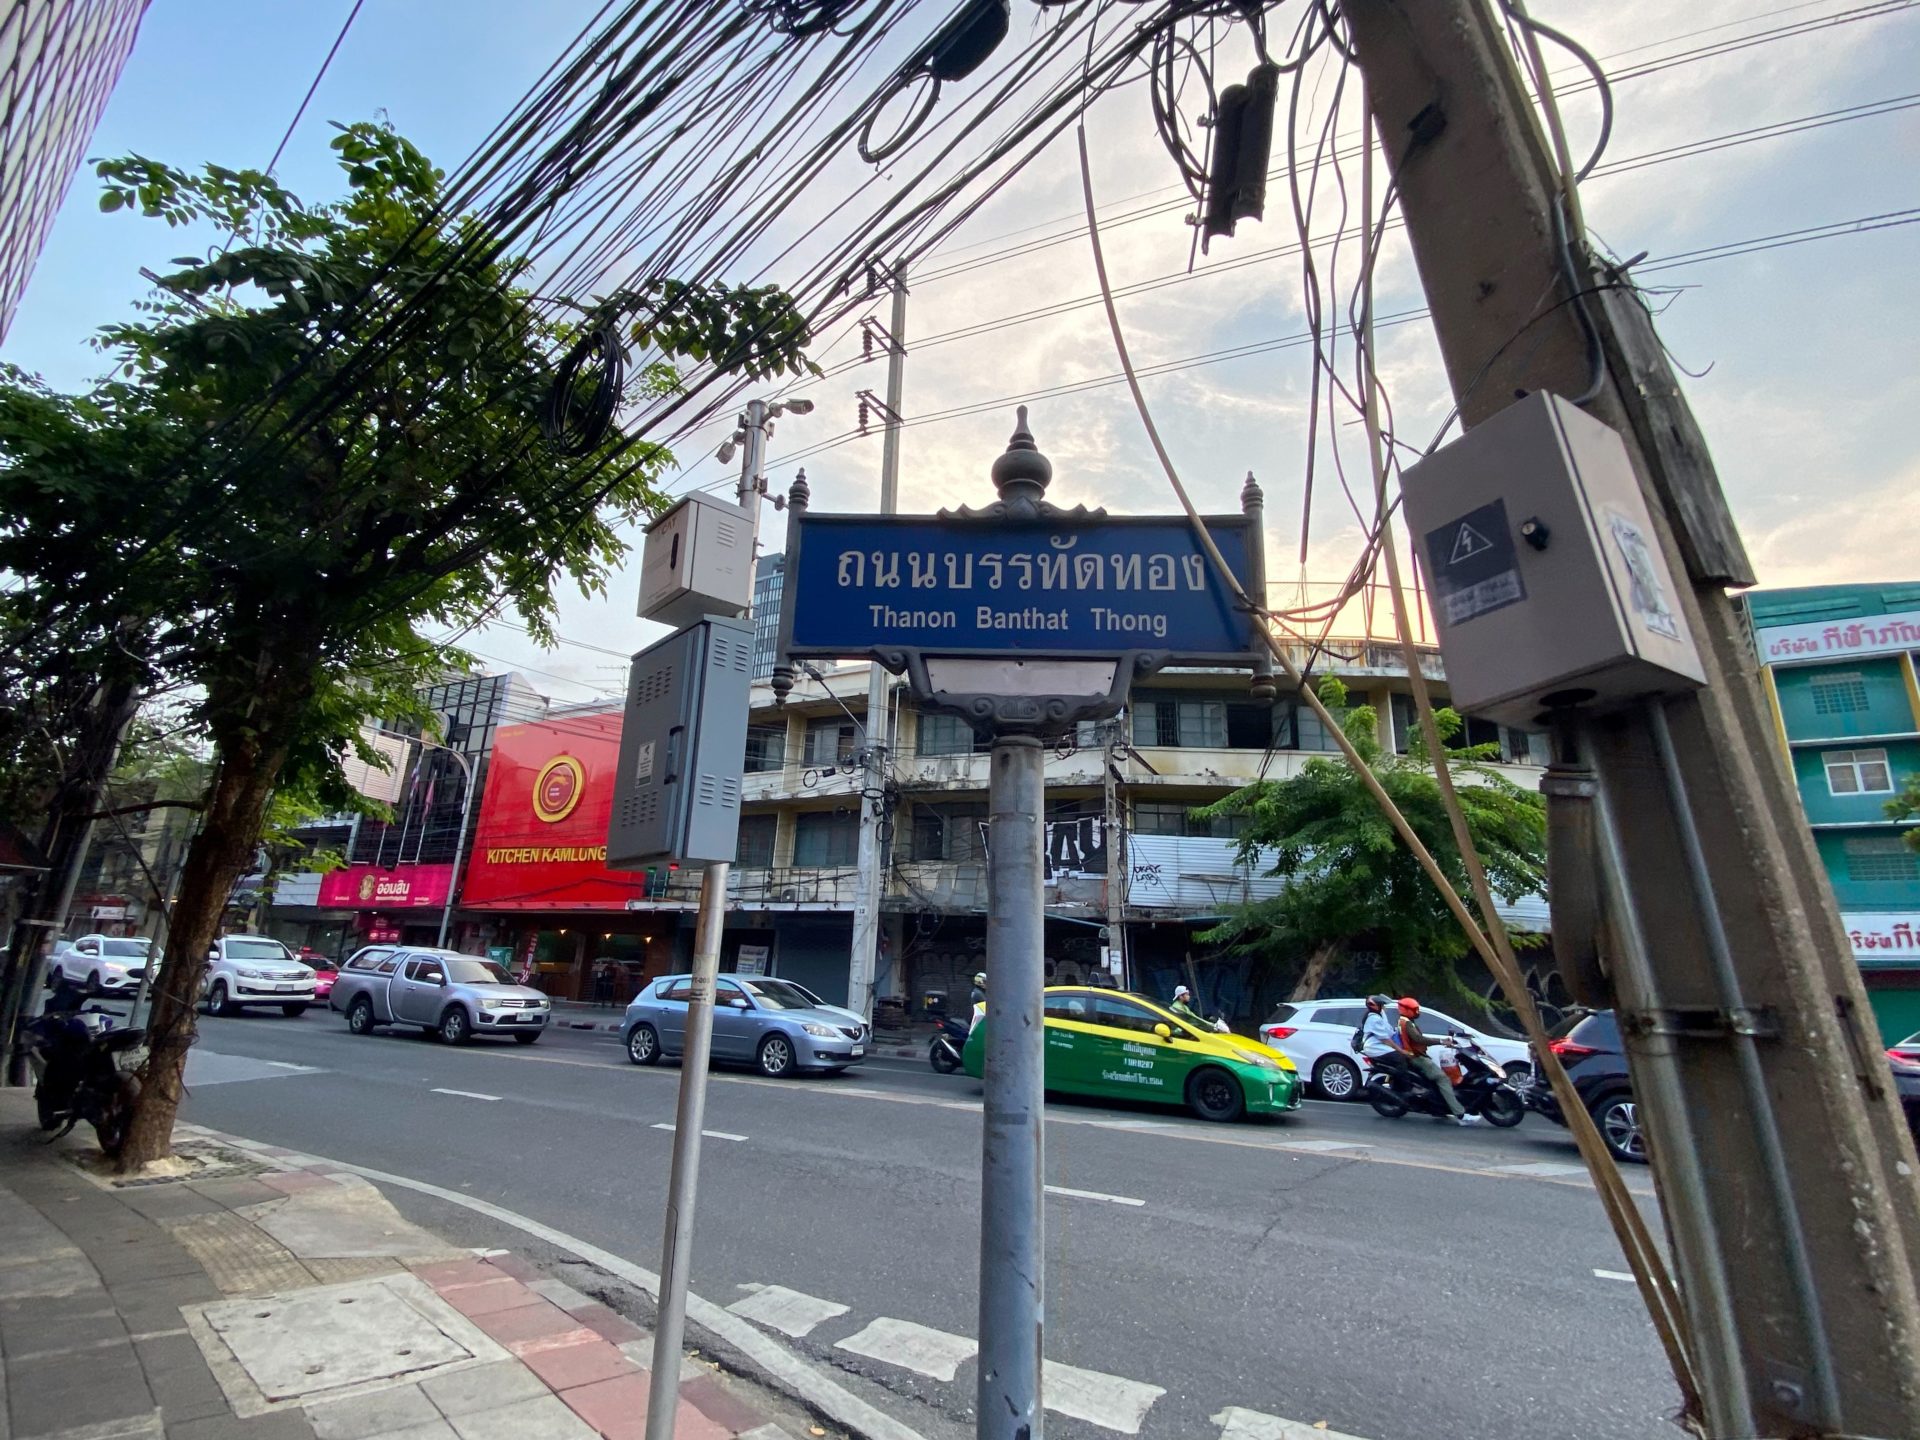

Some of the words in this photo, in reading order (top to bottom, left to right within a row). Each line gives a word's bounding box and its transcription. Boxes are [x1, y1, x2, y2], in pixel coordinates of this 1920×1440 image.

[837, 535, 1205, 591] ถนนบรรทัดทอง
[869, 605, 956, 628] Thanon
[976, 606, 1069, 630] Banthat
[1090, 607, 1167, 638] Thong
[1770, 637, 1818, 656] บริษัท
[486, 848, 540, 864] KITCHEN
[541, 846, 608, 863] KAMLUNG
[376, 879, 411, 895] ออมสิน
[1849, 930, 1892, 949] ริษัท
